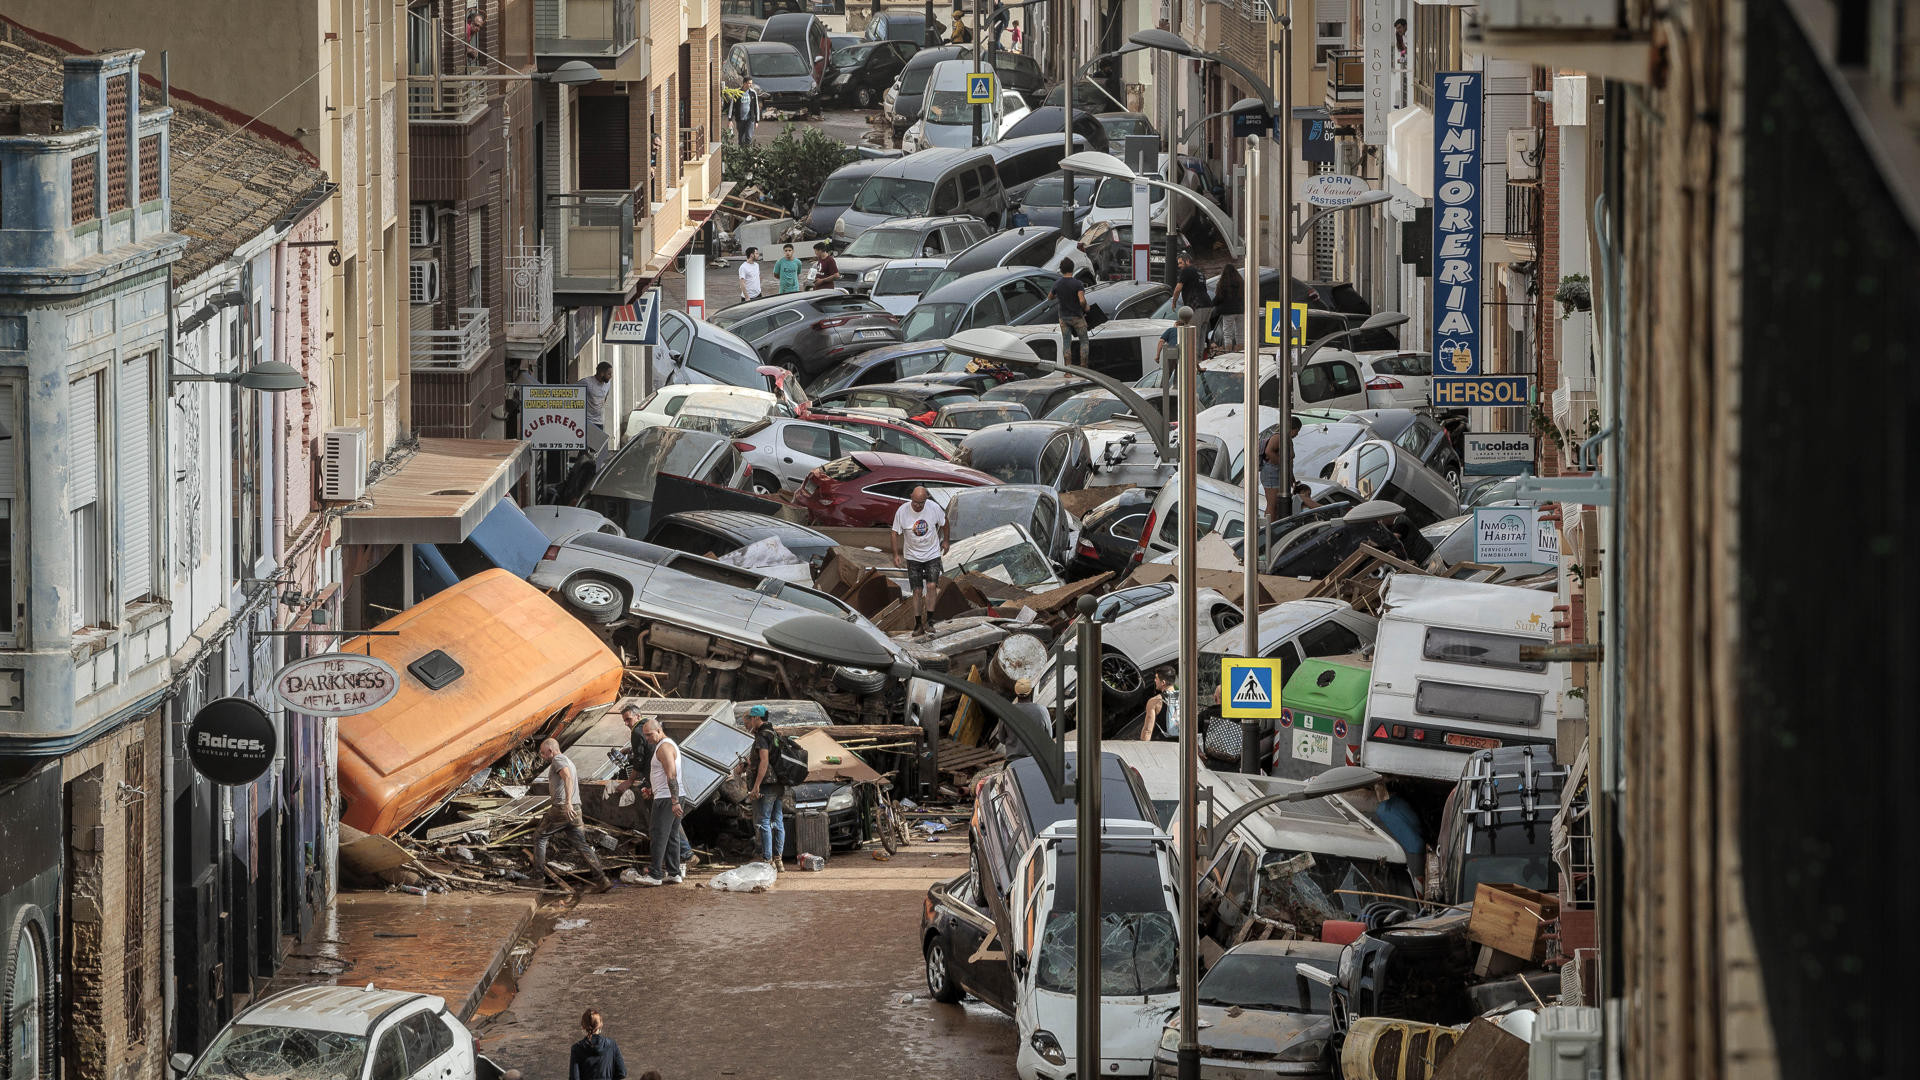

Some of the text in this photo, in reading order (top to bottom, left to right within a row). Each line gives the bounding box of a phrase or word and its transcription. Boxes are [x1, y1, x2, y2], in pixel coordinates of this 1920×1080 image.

[1371, 48, 1382, 124] ROTGLÀ
[1320, 176, 1352, 184] FORN
[1438, 75, 1475, 335] TINTORERIA
[612, 323, 642, 331] FIATC
[1436, 382, 1525, 402] HERSOL
[524, 415, 585, 439] GUERRERO
[1469, 440, 1529, 451] Tucolada
[1480, 520, 1507, 530] INMO
[1514, 619, 1536, 631] Sun
[324, 659, 345, 672] PUB
[286, 672, 385, 693] DARKNESS
[303, 692, 368, 706] METAL BAR
[198, 731, 260, 750] Raices
